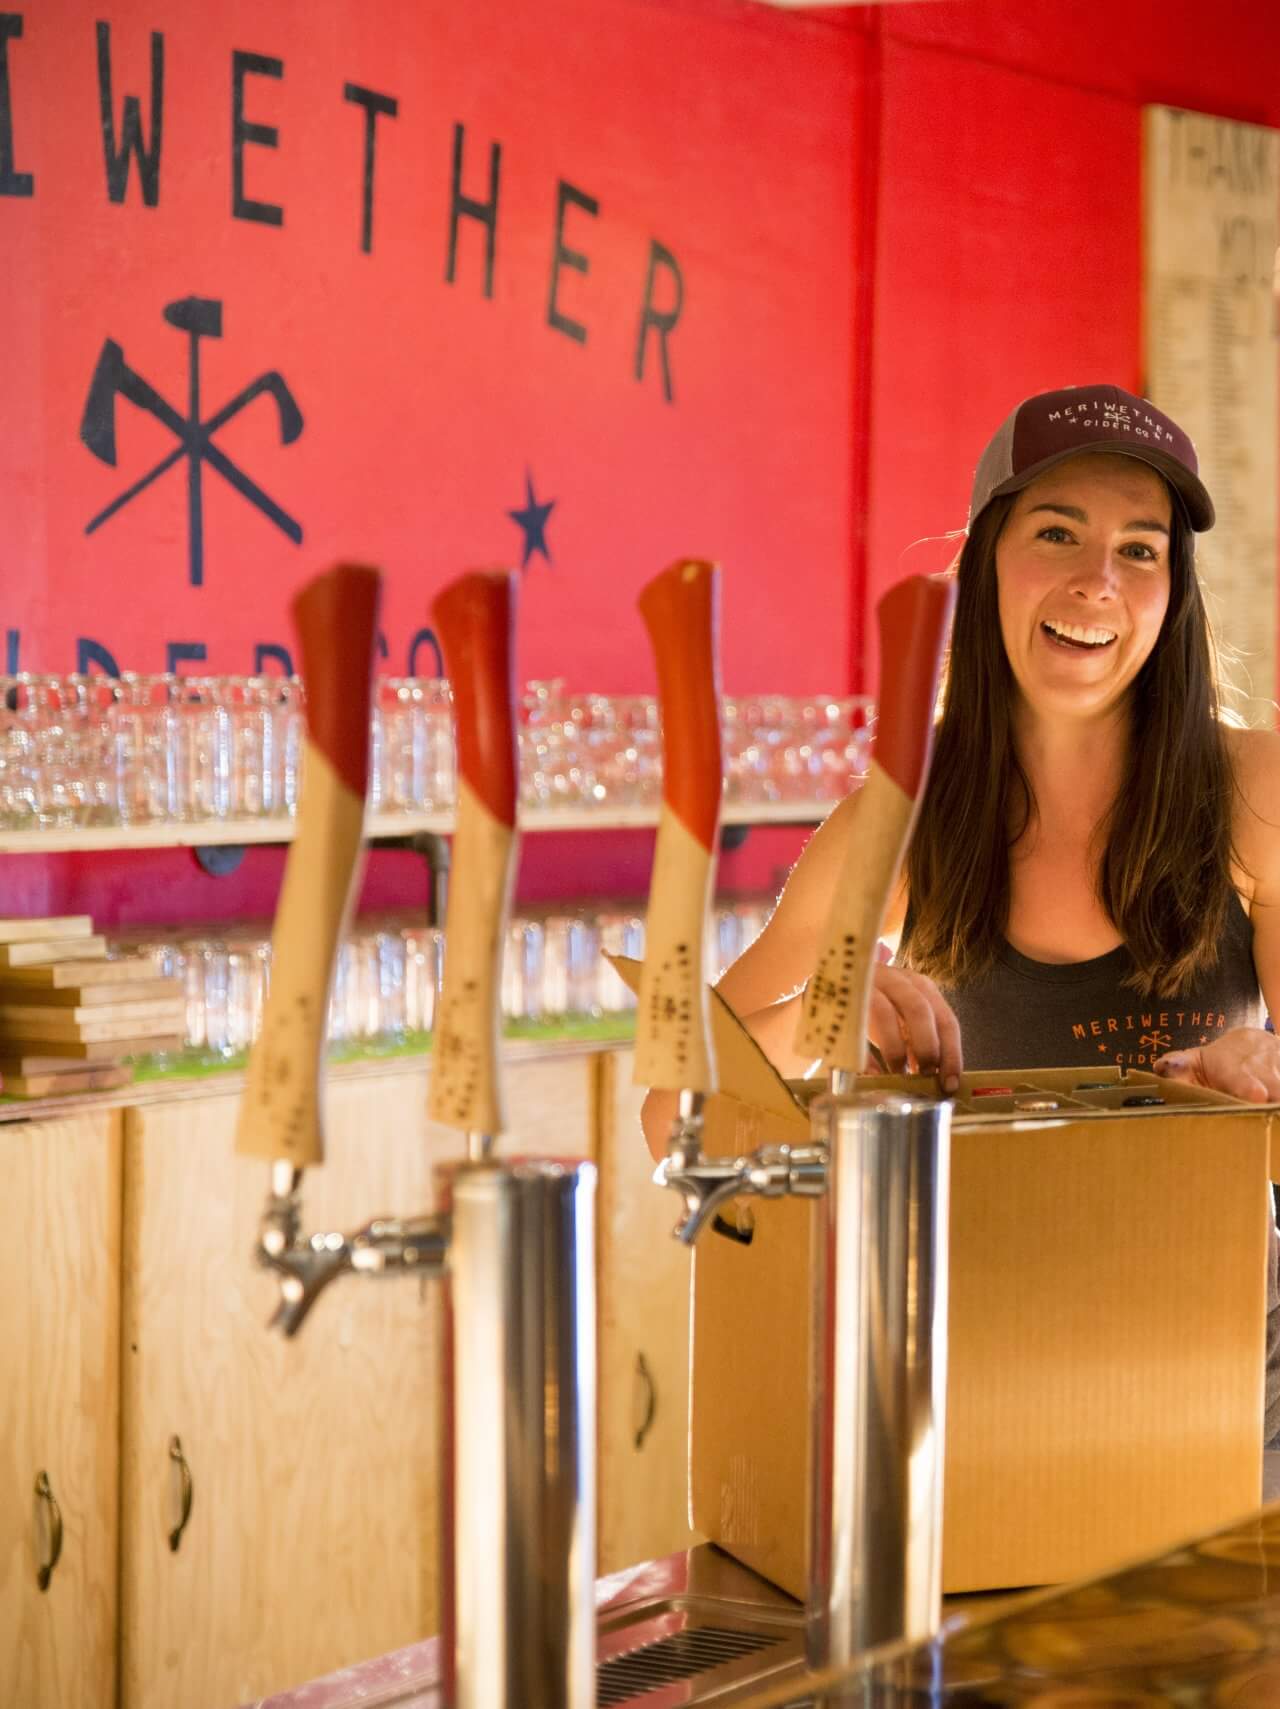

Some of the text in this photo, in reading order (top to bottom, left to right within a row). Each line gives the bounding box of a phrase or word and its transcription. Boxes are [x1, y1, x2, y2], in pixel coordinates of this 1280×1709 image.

[1048, 401, 1174, 442] MERIWETHER
[1084, 418, 1131, 431] CIDER
[1071, 1012, 1226, 1040] MERIWETHER
[1115, 1053, 1157, 1065] CIDE
